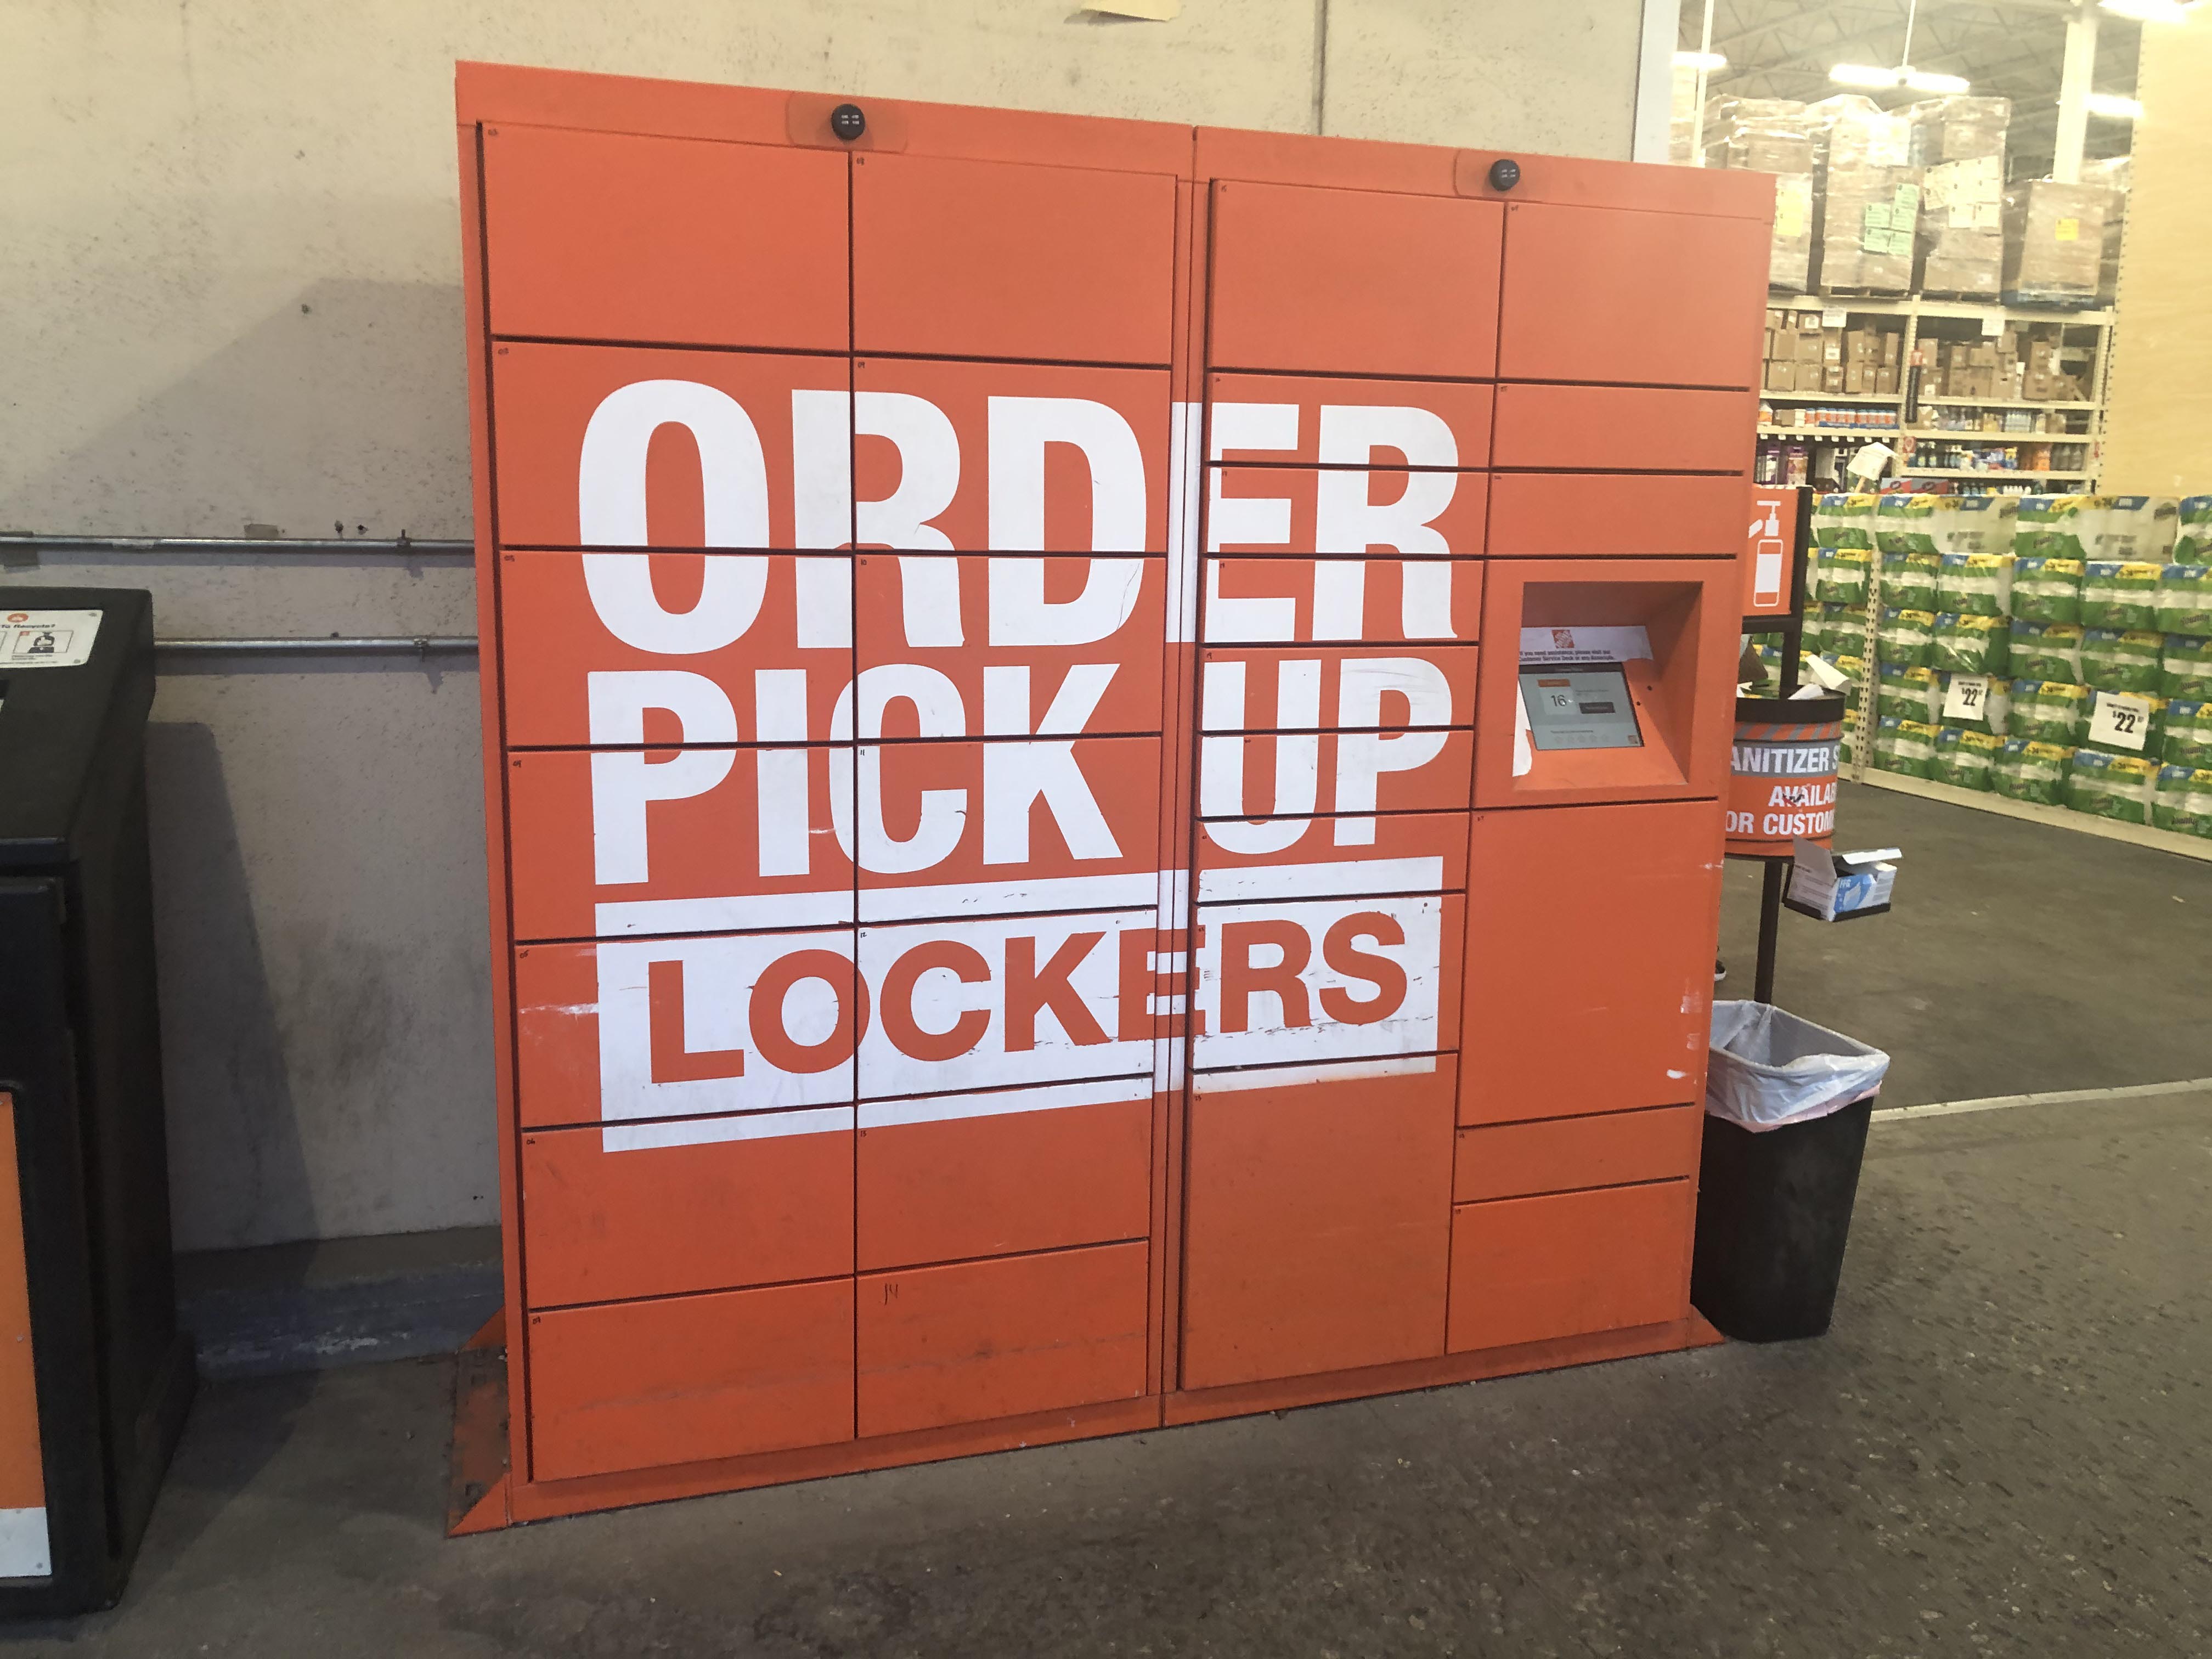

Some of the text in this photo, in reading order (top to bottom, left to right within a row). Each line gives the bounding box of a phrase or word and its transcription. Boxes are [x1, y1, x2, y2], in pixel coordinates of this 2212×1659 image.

[579, 379, 1457, 654] ORDER
[587, 658, 1452, 884] PICK UP
[648, 914, 1408, 1085] LOCKERS
